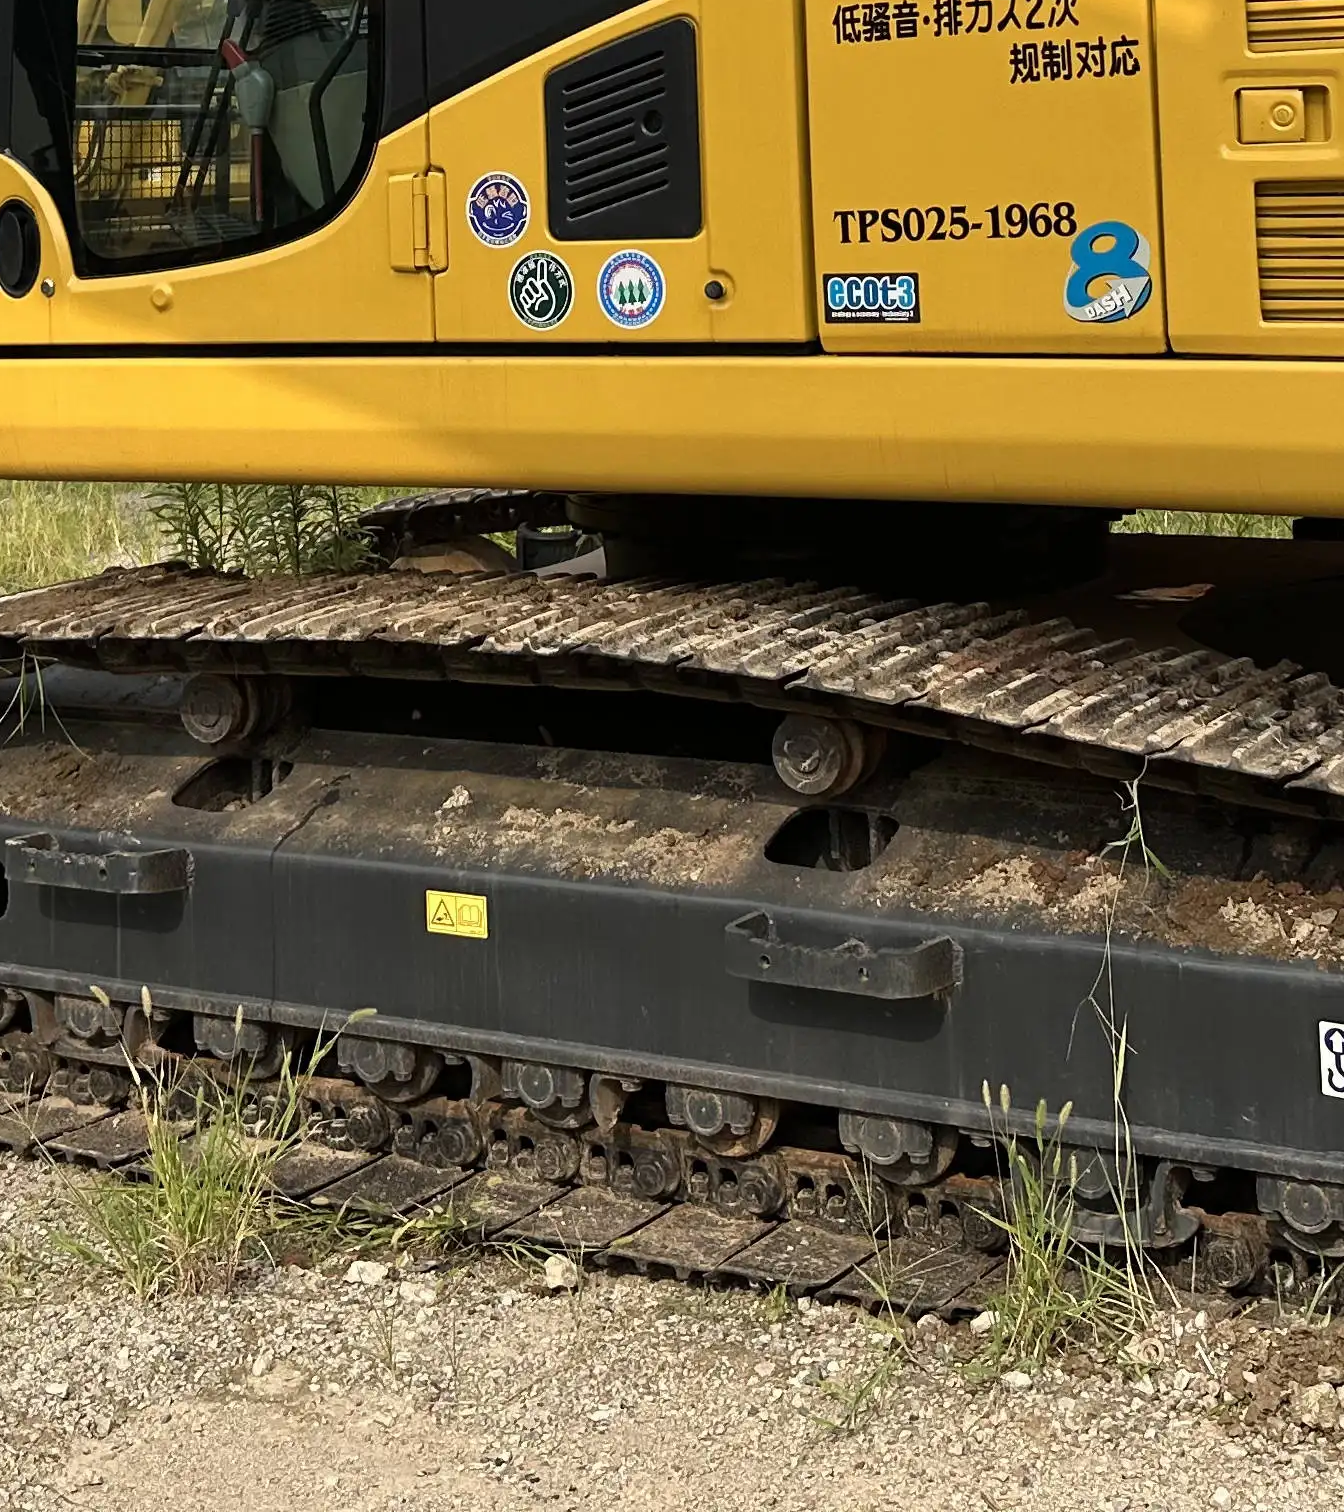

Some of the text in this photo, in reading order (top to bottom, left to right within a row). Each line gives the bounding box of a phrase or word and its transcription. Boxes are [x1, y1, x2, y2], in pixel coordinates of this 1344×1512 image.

[833, 202, 1077, 244] TPS025-1968
[1066, 220, 1152, 322] 8
[827, 275, 916, 310] ecot3
[1084, 283, 1133, 319] DASH
